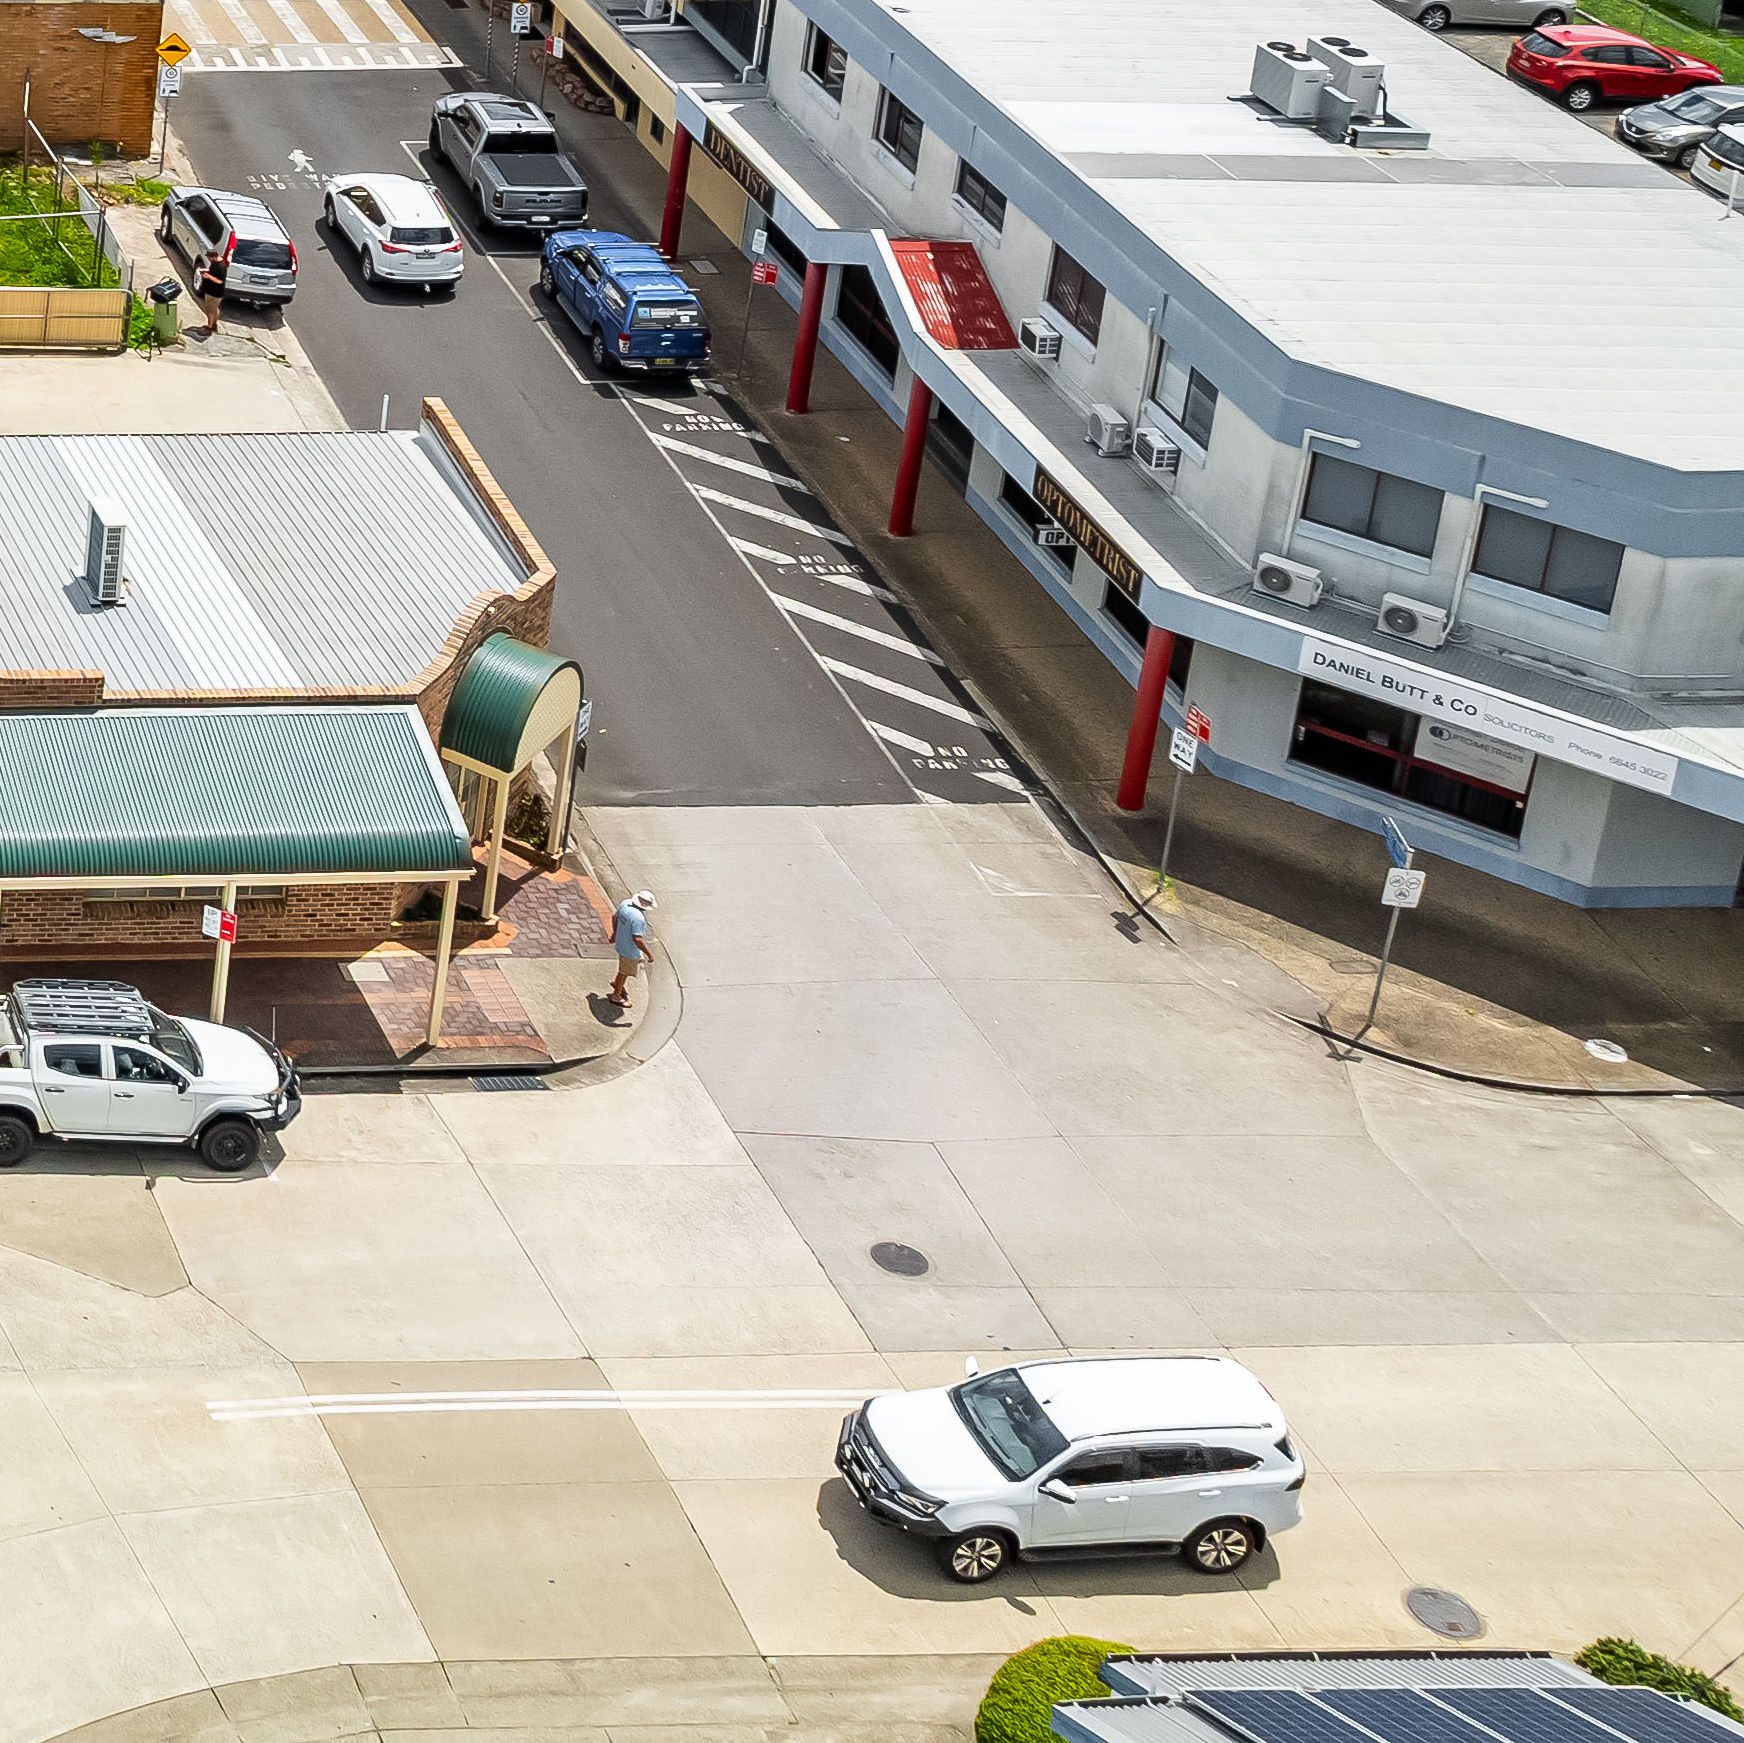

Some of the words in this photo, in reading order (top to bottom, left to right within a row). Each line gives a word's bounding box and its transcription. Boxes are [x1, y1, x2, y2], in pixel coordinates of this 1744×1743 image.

[711, 128, 769, 202] DENTIST
[662, 422, 746, 432] PARKING
[1037, 475, 1139, 592] OPTOMETRIST
[1312, 651, 1376, 684] DANIEL
[1381, 675, 1429, 702] BUTT
[1433, 693, 1445, 708] &
[1449, 698, 1478, 717] CO
[1482, 711, 1556, 745] SOLICITORS
[1568, 741, 1603, 761] Phone
[1639, 764, 1667, 782] 3022
[1176, 731, 1195, 749] ONE
[937, 745, 969, 757] NO
[1173, 742, 1194, 757] WAY
